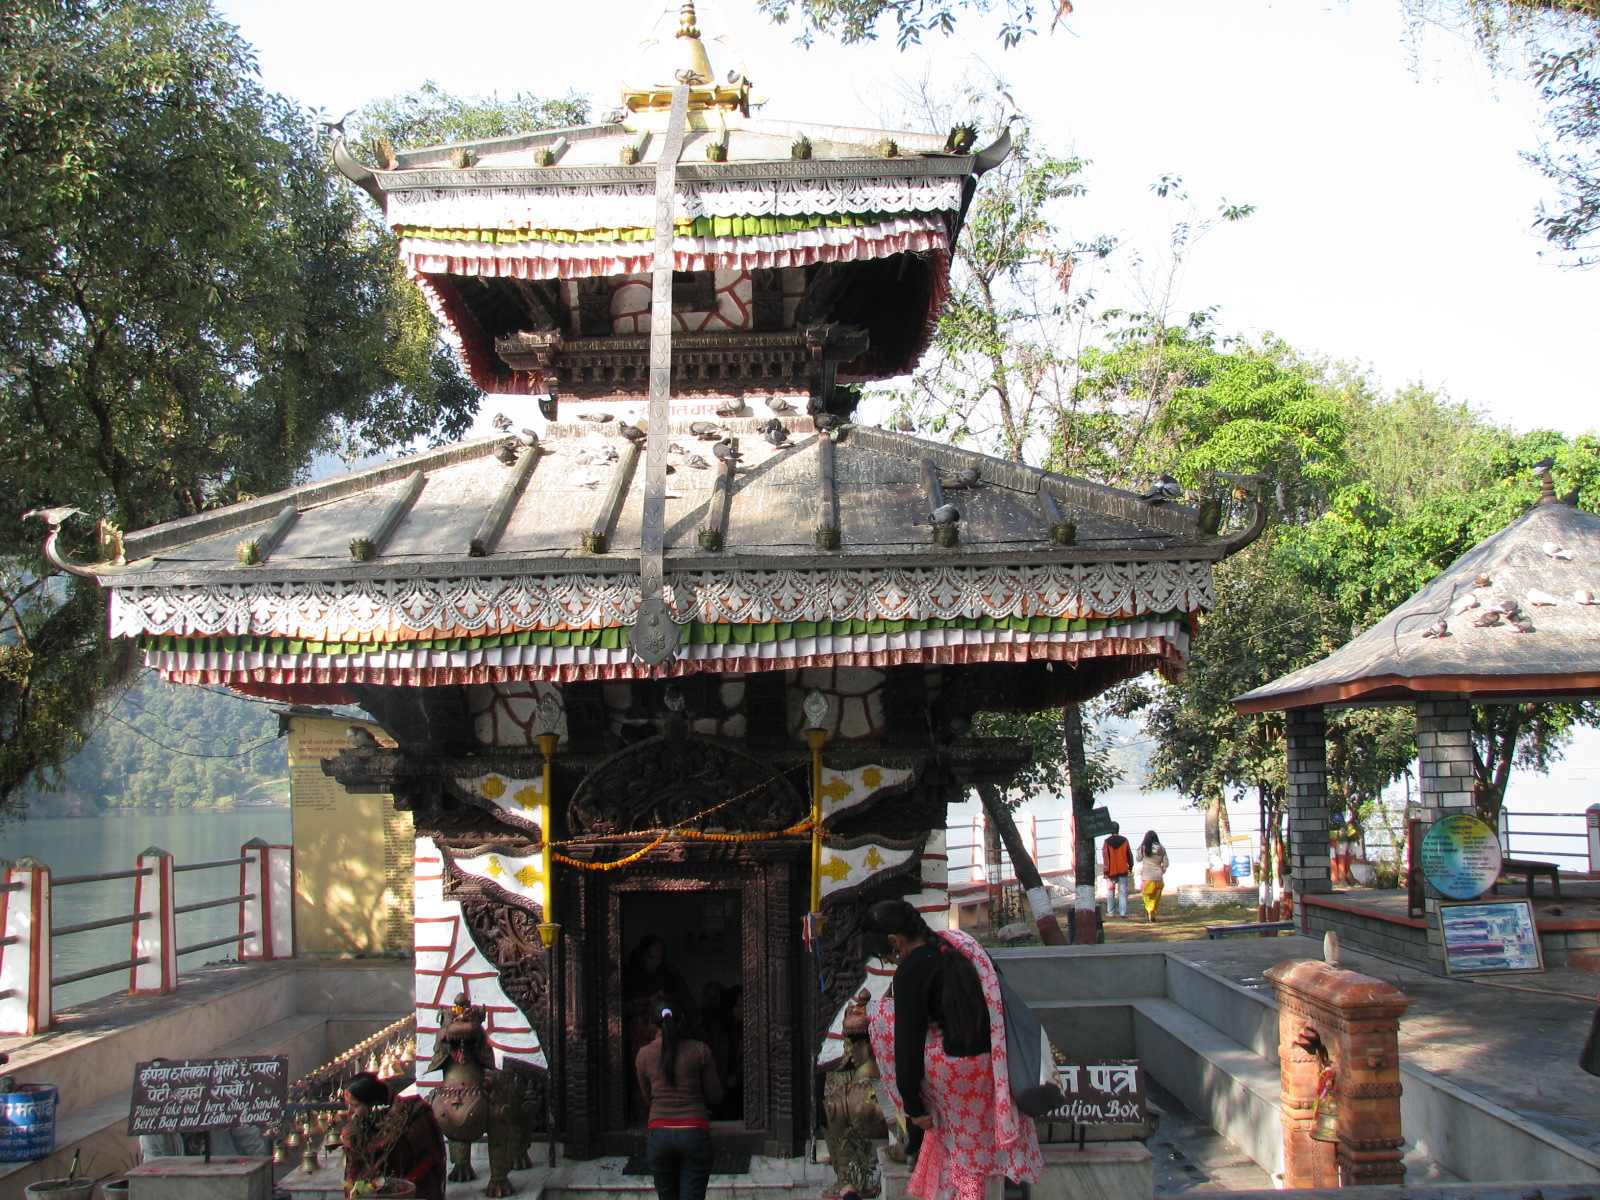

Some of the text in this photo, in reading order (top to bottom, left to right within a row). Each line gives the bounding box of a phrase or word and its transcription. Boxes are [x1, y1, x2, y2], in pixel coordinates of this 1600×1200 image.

[1085, 1065, 1139, 1094] पत्र
[134, 1105, 161, 1118] Please
[183, 1099, 201, 1114] out
[204, 1098, 226, 1113] here
[1104, 1099, 1141, 1120] Box
[133, 1116, 157, 1131] Belt,
[158, 1115, 179, 1131] Bag
[180, 1113, 201, 1127] and
[200, 1111, 237, 1125] Leather
